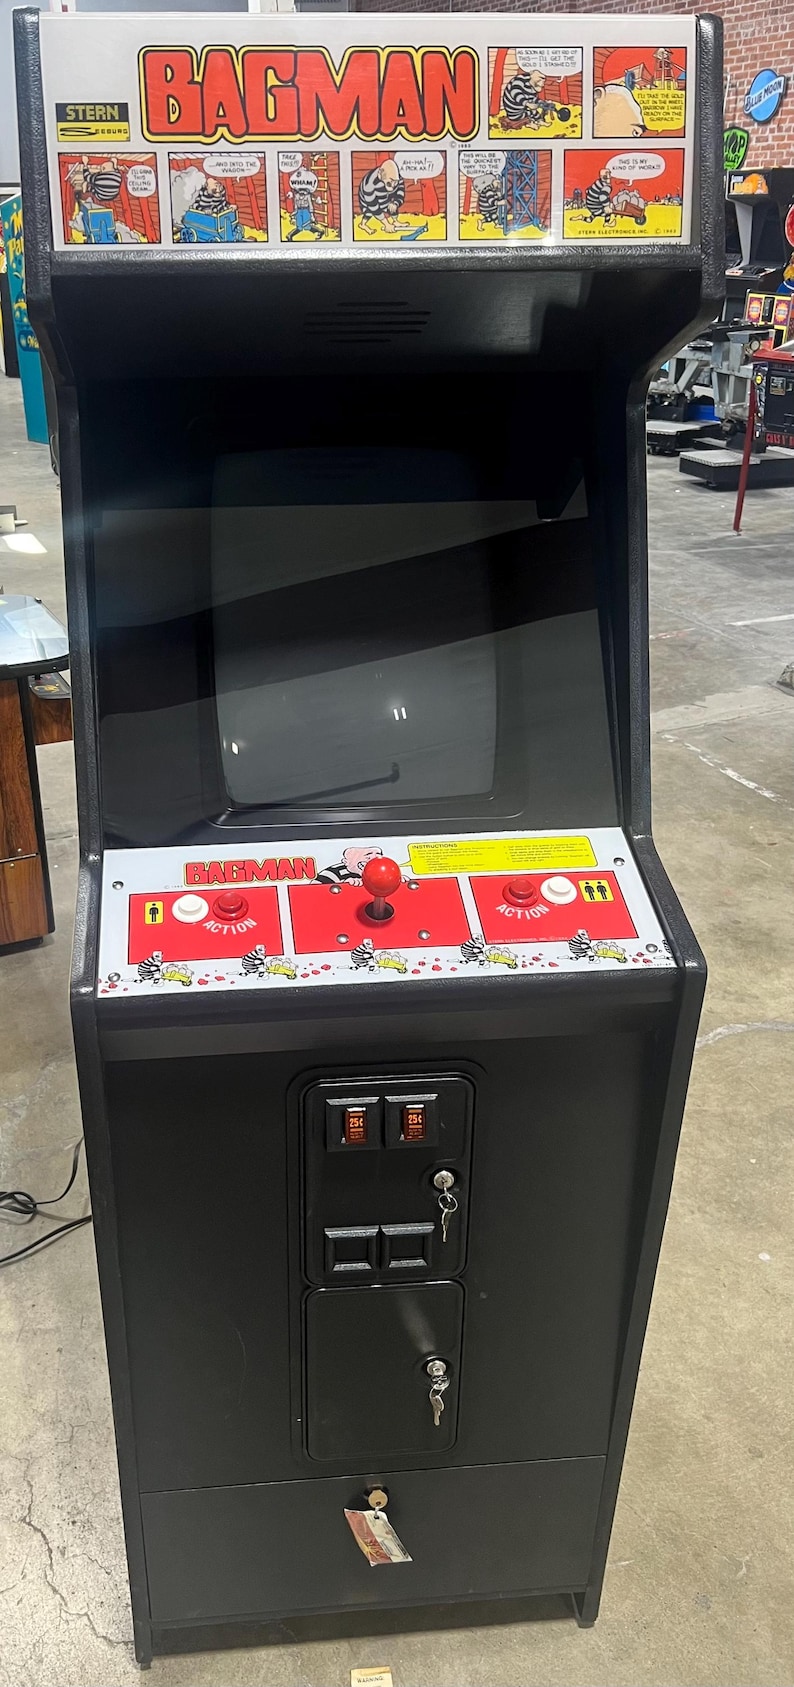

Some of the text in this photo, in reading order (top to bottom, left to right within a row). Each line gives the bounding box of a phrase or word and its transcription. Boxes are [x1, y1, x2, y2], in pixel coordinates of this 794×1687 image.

[139, 46, 479, 142] BAGMAN
[744, 79, 782, 112] BLUE MOON
[66, 105, 118, 120] STERN
[184, 857, 316, 886] BAGMAN
[496, 903, 550, 920] ACTION
[203, 916, 257, 935] ACTION
[350, 1117, 364, 1128] 25¢
[408, 1114, 422, 1124] 25¢
